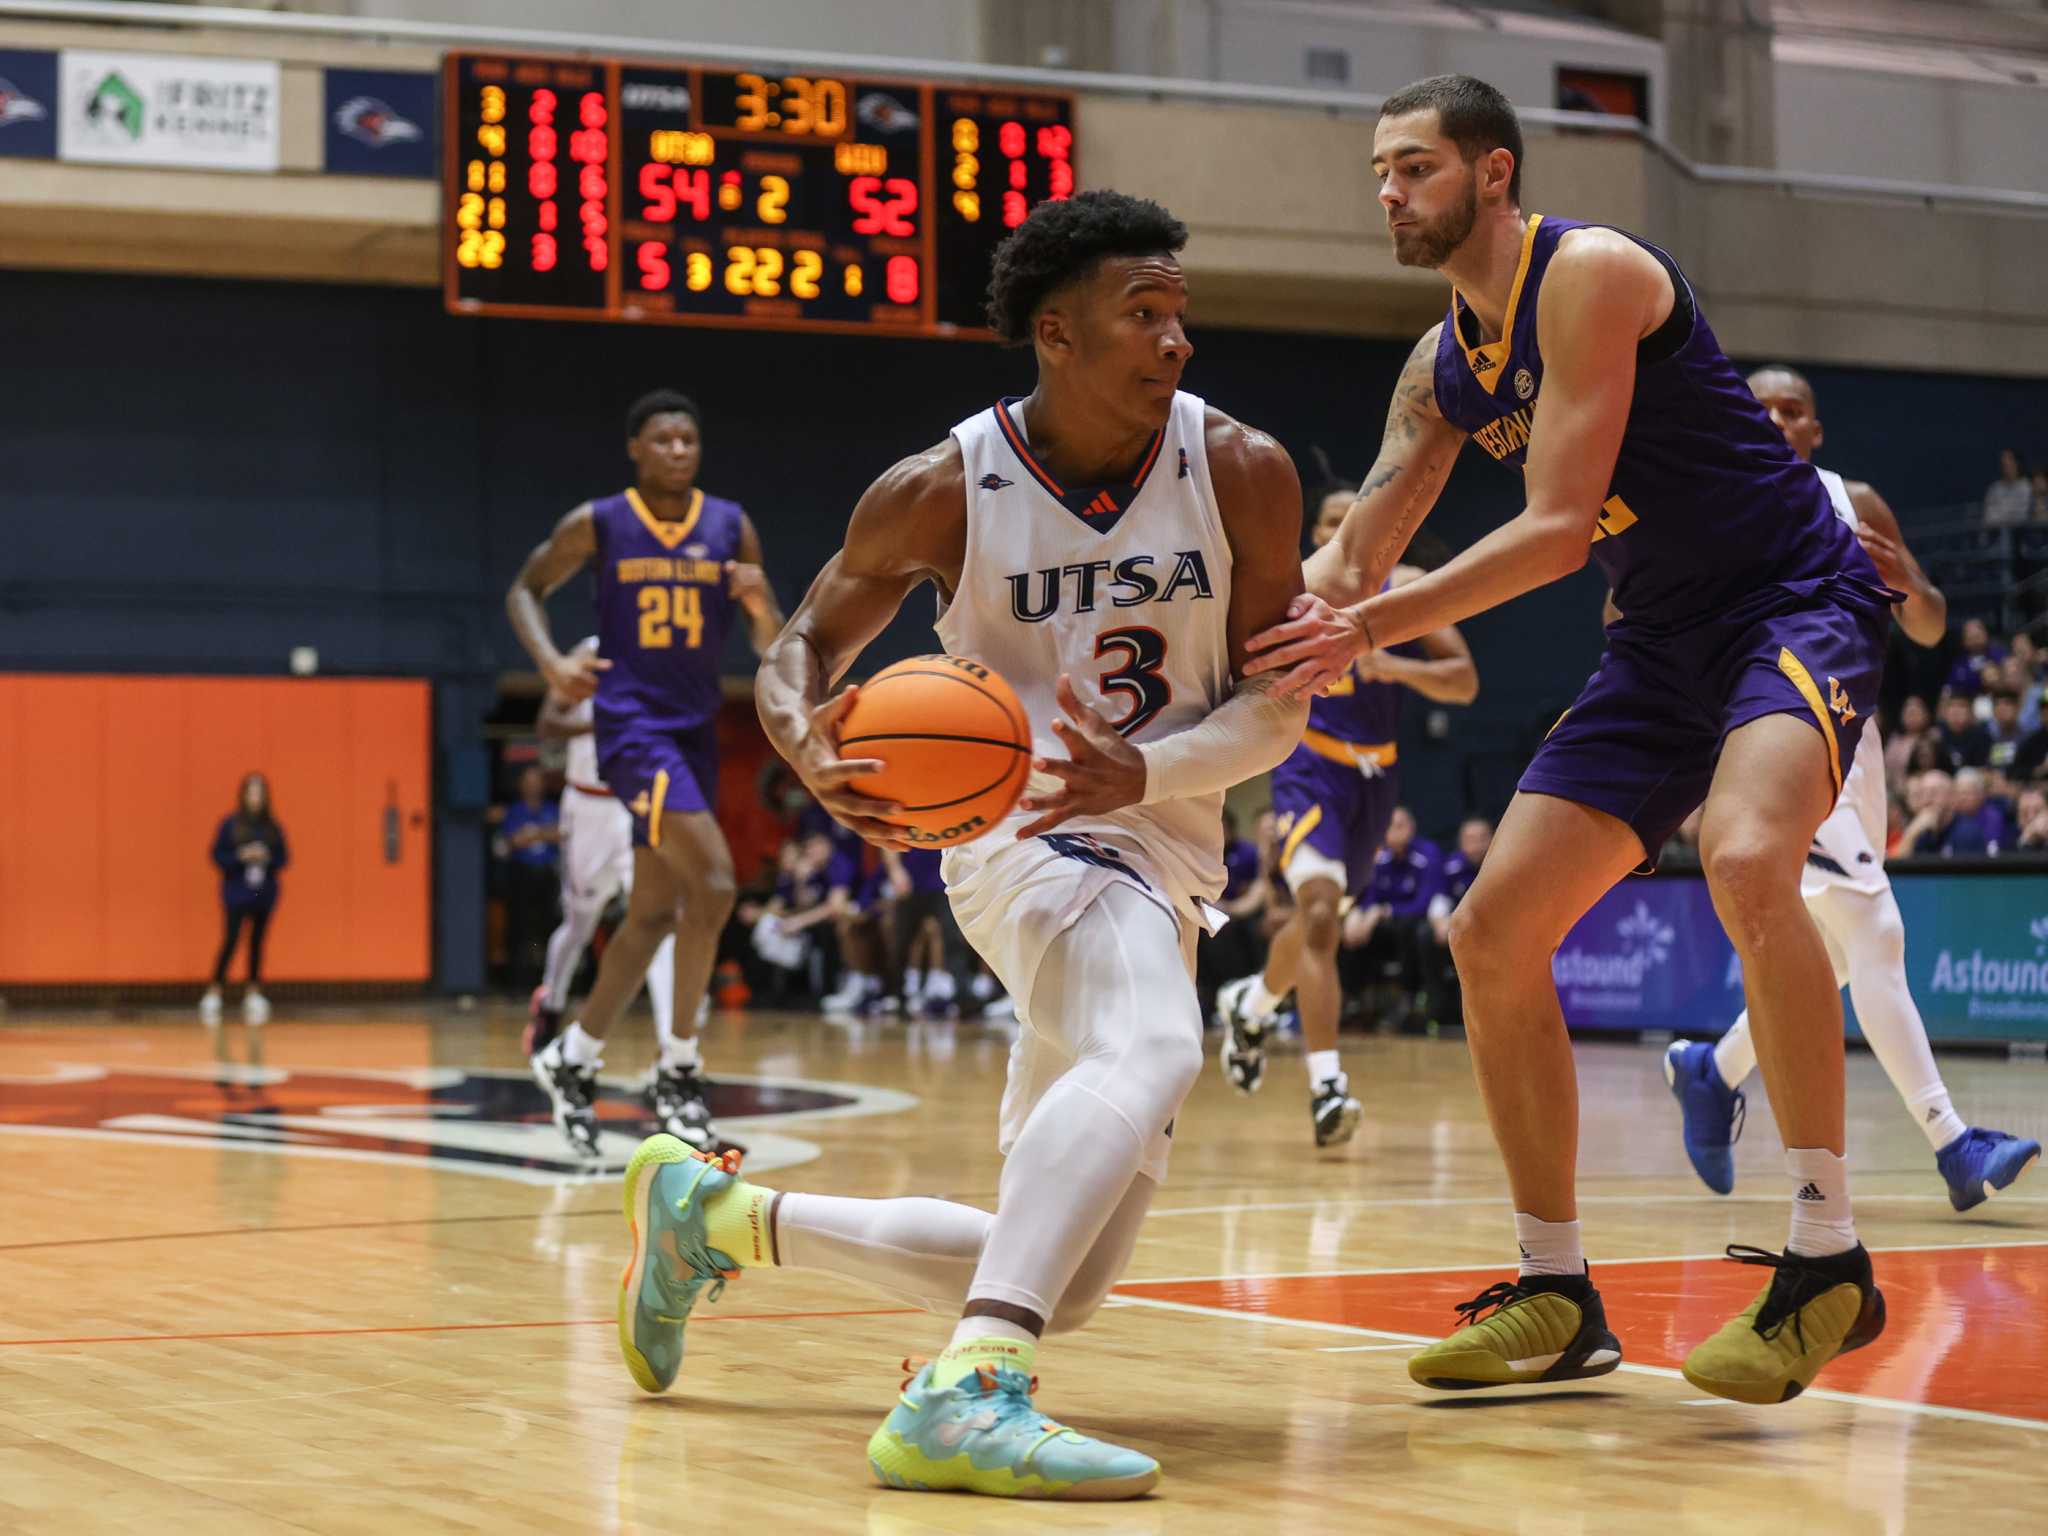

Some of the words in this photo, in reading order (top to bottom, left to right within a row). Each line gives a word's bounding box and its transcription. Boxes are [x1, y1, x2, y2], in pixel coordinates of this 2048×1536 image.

[480, 86, 506, 124] 3
[735, 74, 846, 136] 3:30
[639, 162, 710, 222] 54
[757, 175, 790, 224] 2
[849, 176, 918, 237] 52
[637, 241, 671, 291] 5
[686, 252, 712, 291] 3
[724, 246, 784, 296] 22
[790, 250, 823, 299] 2
[637, 585, 704, 649] 24
[1004, 550, 1214, 623] UTSA
[1094, 625, 1172, 738] 3
[1554, 946, 1643, 988] stound
